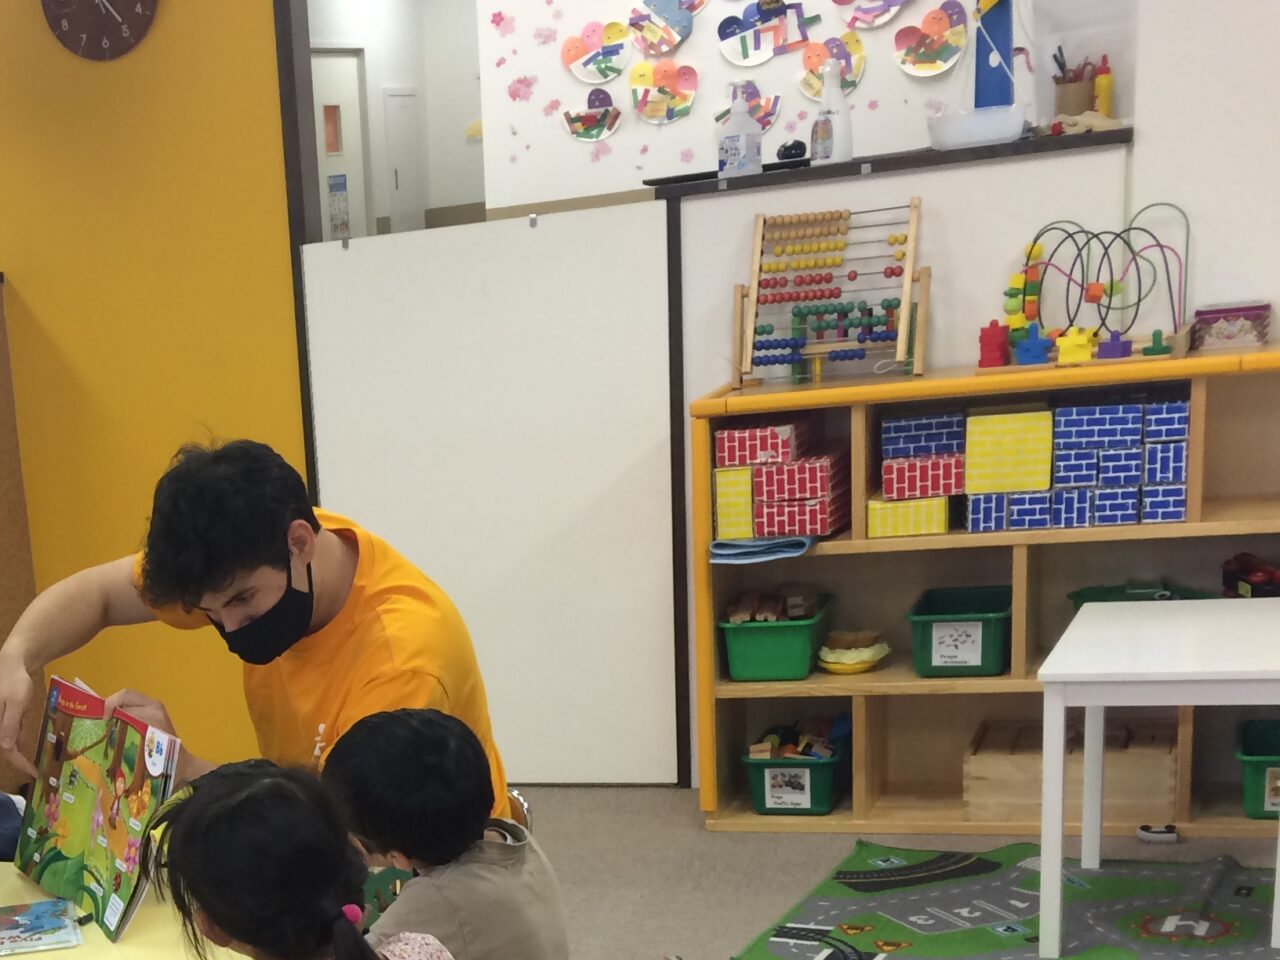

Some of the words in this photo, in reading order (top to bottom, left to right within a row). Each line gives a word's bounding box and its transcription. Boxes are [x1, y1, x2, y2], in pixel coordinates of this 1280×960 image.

[135, 3, 142, 14] 4
[61, 19, 69, 31] 8
[121, 24, 130, 37] 5
[80, 34, 87, 46] 7
[102, 36, 110, 48] 6
[953, 907, 981, 918] 2
[908, 915, 936, 925] 3
[1160, 915, 1210, 936] H
